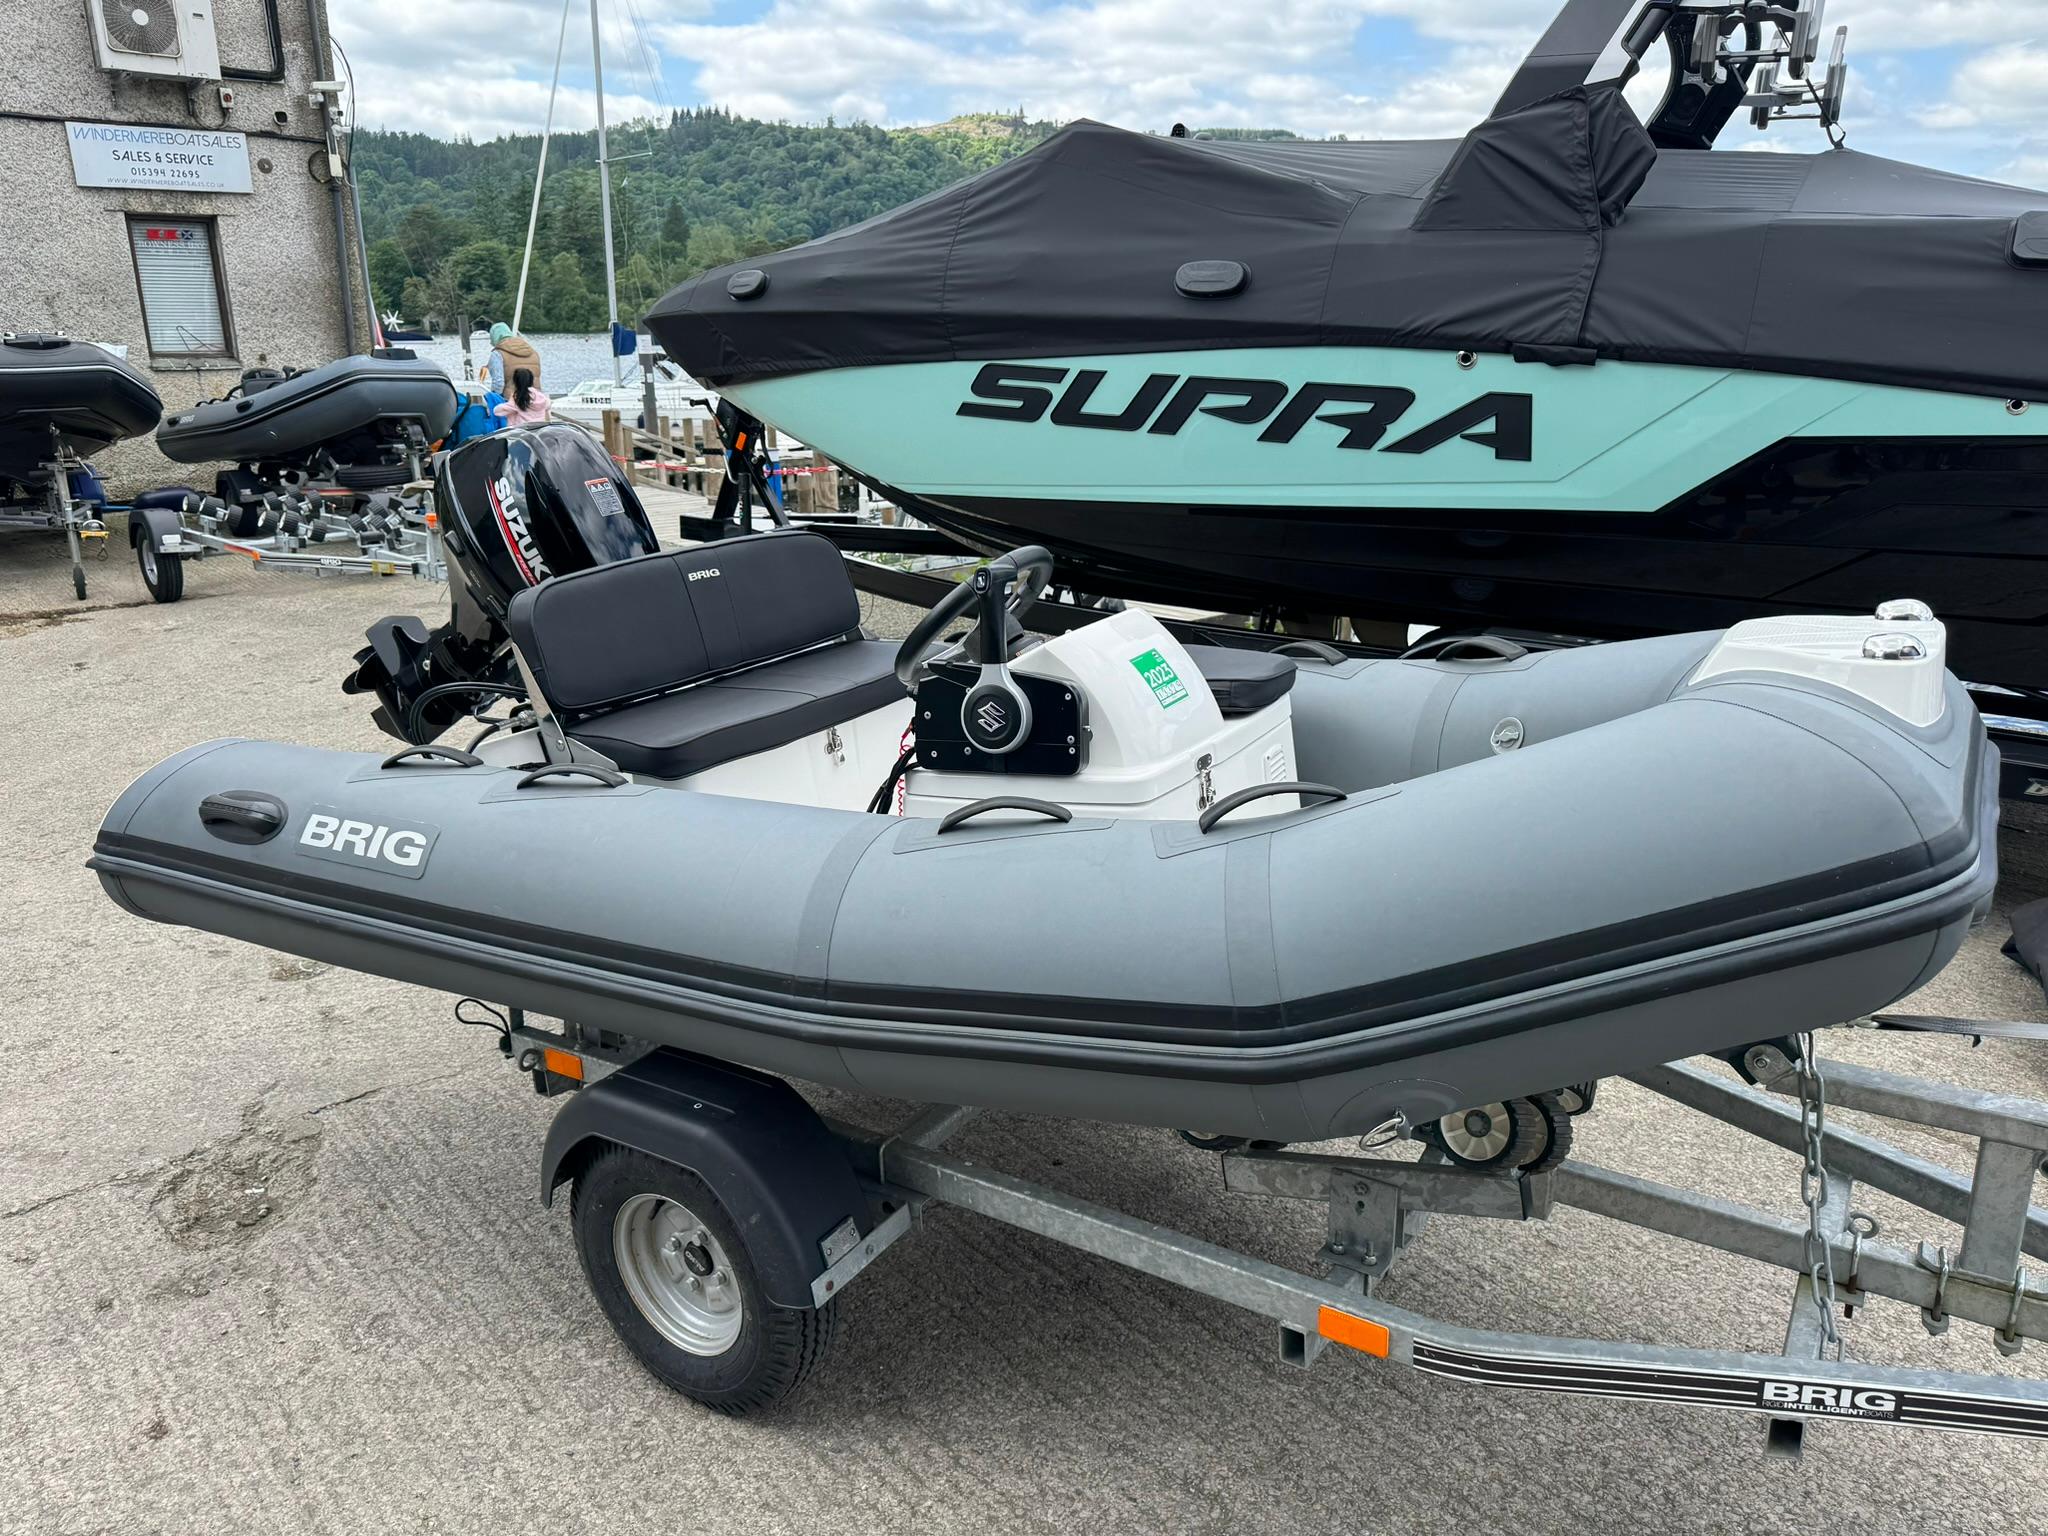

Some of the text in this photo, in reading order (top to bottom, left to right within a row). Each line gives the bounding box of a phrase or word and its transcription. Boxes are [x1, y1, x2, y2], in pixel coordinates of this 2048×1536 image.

[73, 126, 241, 149] WINDERMEREBOATSALES
[112, 150, 214, 166] SALES & SERVICE
[131, 167, 200, 179] 015394 22695
[955, 361, 1533, 462] SUPRA
[494, 477, 553, 582] SUZUK
[688, 568, 721, 582] BRIG
[1143, 662, 1175, 689] 2023
[300, 813, 427, 867] BRIG
[1762, 1381, 1897, 1412] BRIG
